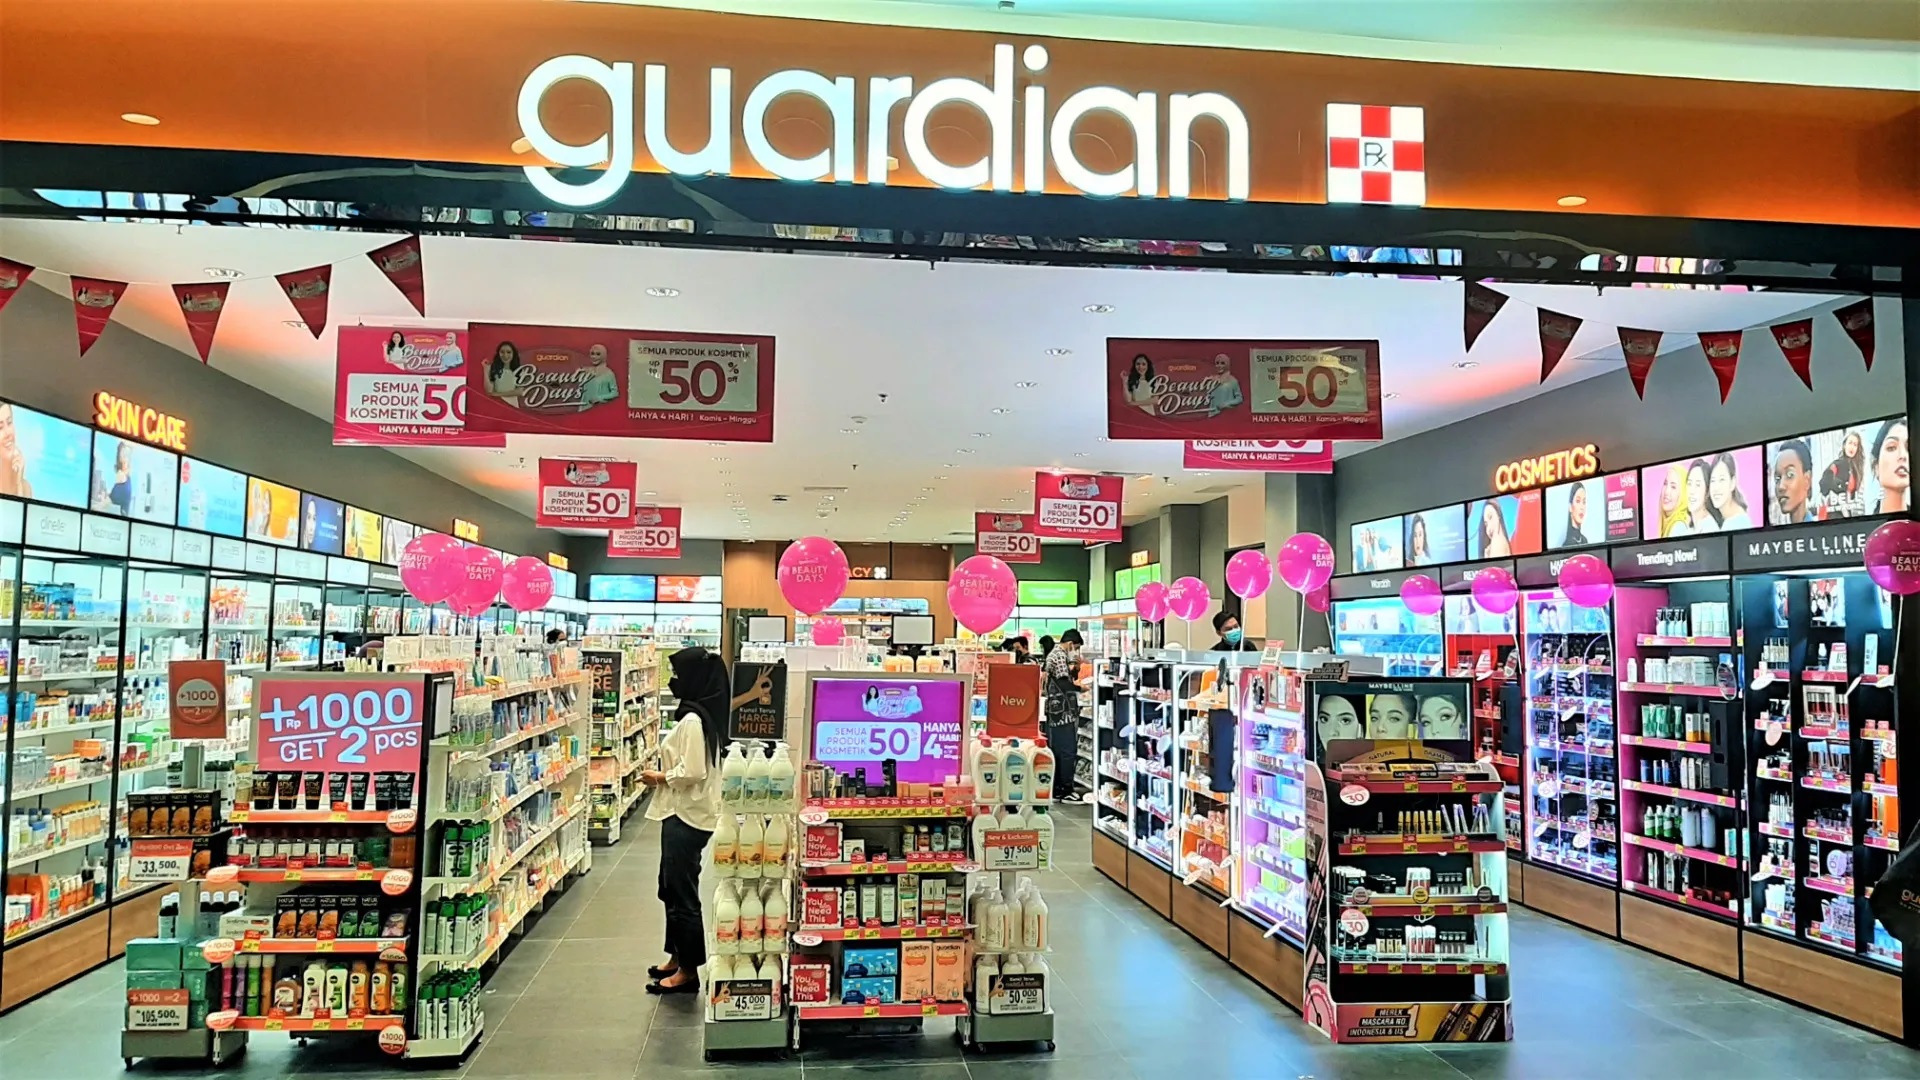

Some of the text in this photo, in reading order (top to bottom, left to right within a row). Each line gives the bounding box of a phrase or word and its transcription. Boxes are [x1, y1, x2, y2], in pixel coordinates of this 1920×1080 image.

[517, 44, 1249, 206] guardian
[402, 344, 446, 357] Beauty
[637, 347, 751, 359] SEMUA PRODUK KOSMETIK
[406, 357, 442, 370] Days
[536, 354, 569, 362] guardian
[1256, 355, 1283, 363] SEMUA
[1168, 364, 1197, 372] guardian
[514, 364, 596, 387] Beauty
[373, 382, 419, 393] SEMUA
[659, 360, 726, 405] 50
[1149, 374, 1220, 396] Beauty
[1278, 366, 1338, 408] 50
[362, 395, 419, 407] PRODUK
[523, 384, 584, 407] Days
[1158, 393, 1212, 414] Days
[350, 408, 418, 420] KOSMETIK
[628, 411, 659, 419] HANYA
[699, 414, 722, 422] Kamis
[729, 416, 757, 425] Minggu
[97, 391, 187, 450] SKIN CARE
[1343, 416, 1368, 424] Minggu
[379, 425, 409, 434] HANYA
[411, 426, 418, 434] 4
[1222, 452, 1248, 460] HANYA
[1495, 444, 1597, 493] COSMETICS
[586, 492, 621, 514] 50
[1042, 517, 1077, 525] KOSMETIK
[1078, 505, 1110, 526] 50
[644, 530, 670, 546] 50
[1007, 536, 1031, 552] 50
[1749, 533, 1867, 556] MAYBELLINE
[1637, 548, 1698, 567] Trending Now!
[1891, 556, 1920, 565] BEAU
[466, 565, 496, 575] BEAUTY
[792, 565, 828, 575] BEAUTY
[469, 572, 493, 581] DAYS
[797, 574, 823, 583] DAYS
[591, 656, 613, 664] Terus
[584, 664, 611, 675] RGA
[592, 677, 612, 689] RE
[180, 690, 217, 701] +1000
[1000, 695, 1026, 706] New
[195, 707, 201, 715] 2
[739, 713, 776, 723] HARGA
[286, 718, 301, 732] Rp
[738, 723, 776, 734] MURE
[923, 722, 961, 733] HANYA
[280, 727, 418, 764] GET 2 pcs
[827, 737, 866, 745] PRODUK
[869, 728, 910, 755] 50
[923, 734, 943, 759] 4
[819, 746, 866, 755] KOSMETIK
[1368, 751, 1396, 760] NATURAL
[1349, 793, 1364, 804] 30
[808, 834, 825, 844] Buy
[808, 907, 832, 915] Need
[809, 915, 825, 923] This
[1349, 922, 1364, 933] 30
[795, 975, 810, 983] You
[796, 984, 820, 992] Need
[1361, 1018, 1395, 1026] MASCARA
[1405, 1005, 1420, 1036] 1
[1349, 1028, 1386, 1036] INDONESIA
